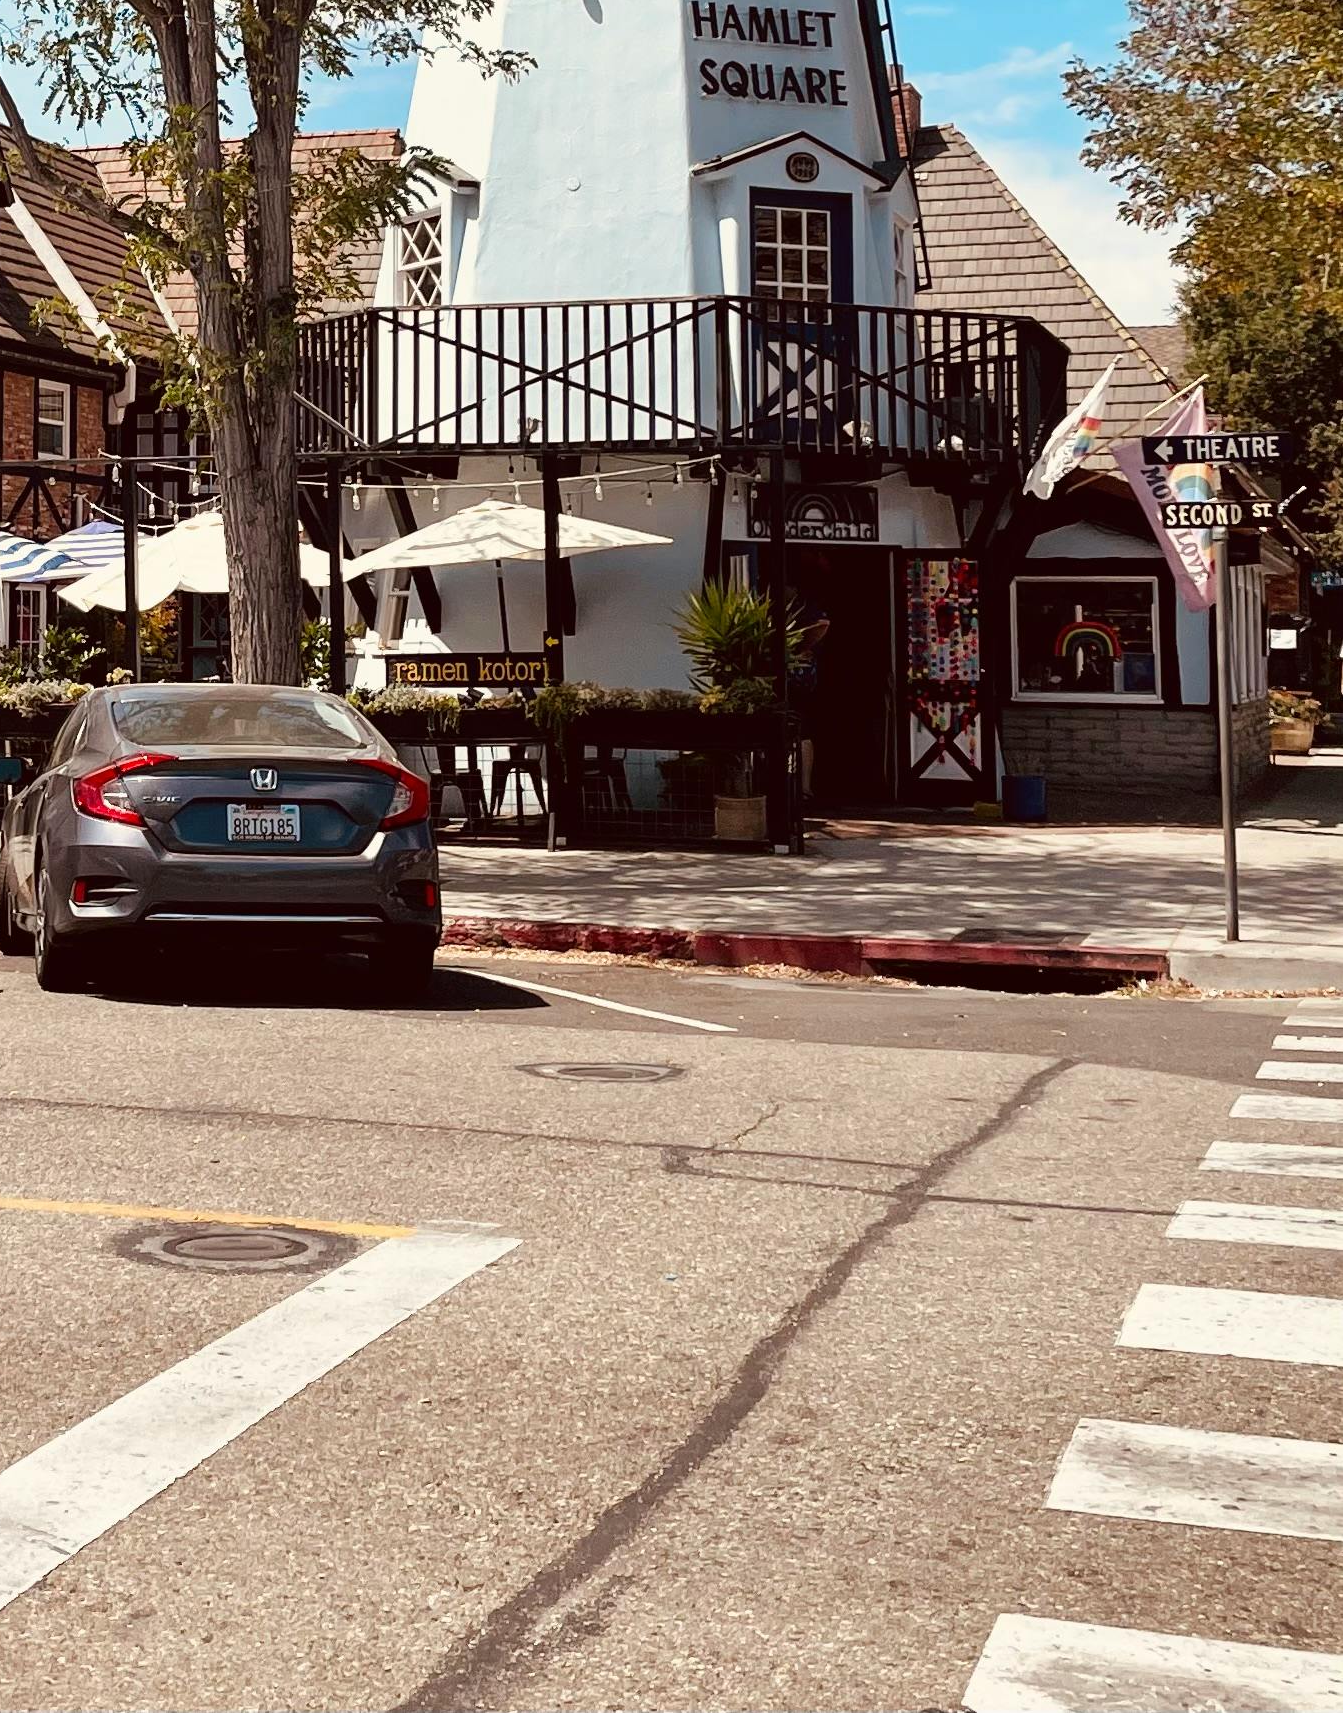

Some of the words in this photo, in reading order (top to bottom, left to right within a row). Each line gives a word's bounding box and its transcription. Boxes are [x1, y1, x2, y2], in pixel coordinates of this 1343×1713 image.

[691, 0, 836, 48] HAMLET
[699, 58, 848, 106] SQUARE
[1183, 435, 1280, 461] THEATRE
[1165, 503, 1243, 527] SECOND
[394, 661, 470, 683] ramen
[478, 656, 550, 684] kotori
[142, 795, 182, 803] CIVIC
[233, 817, 294, 835] 8RTG185
